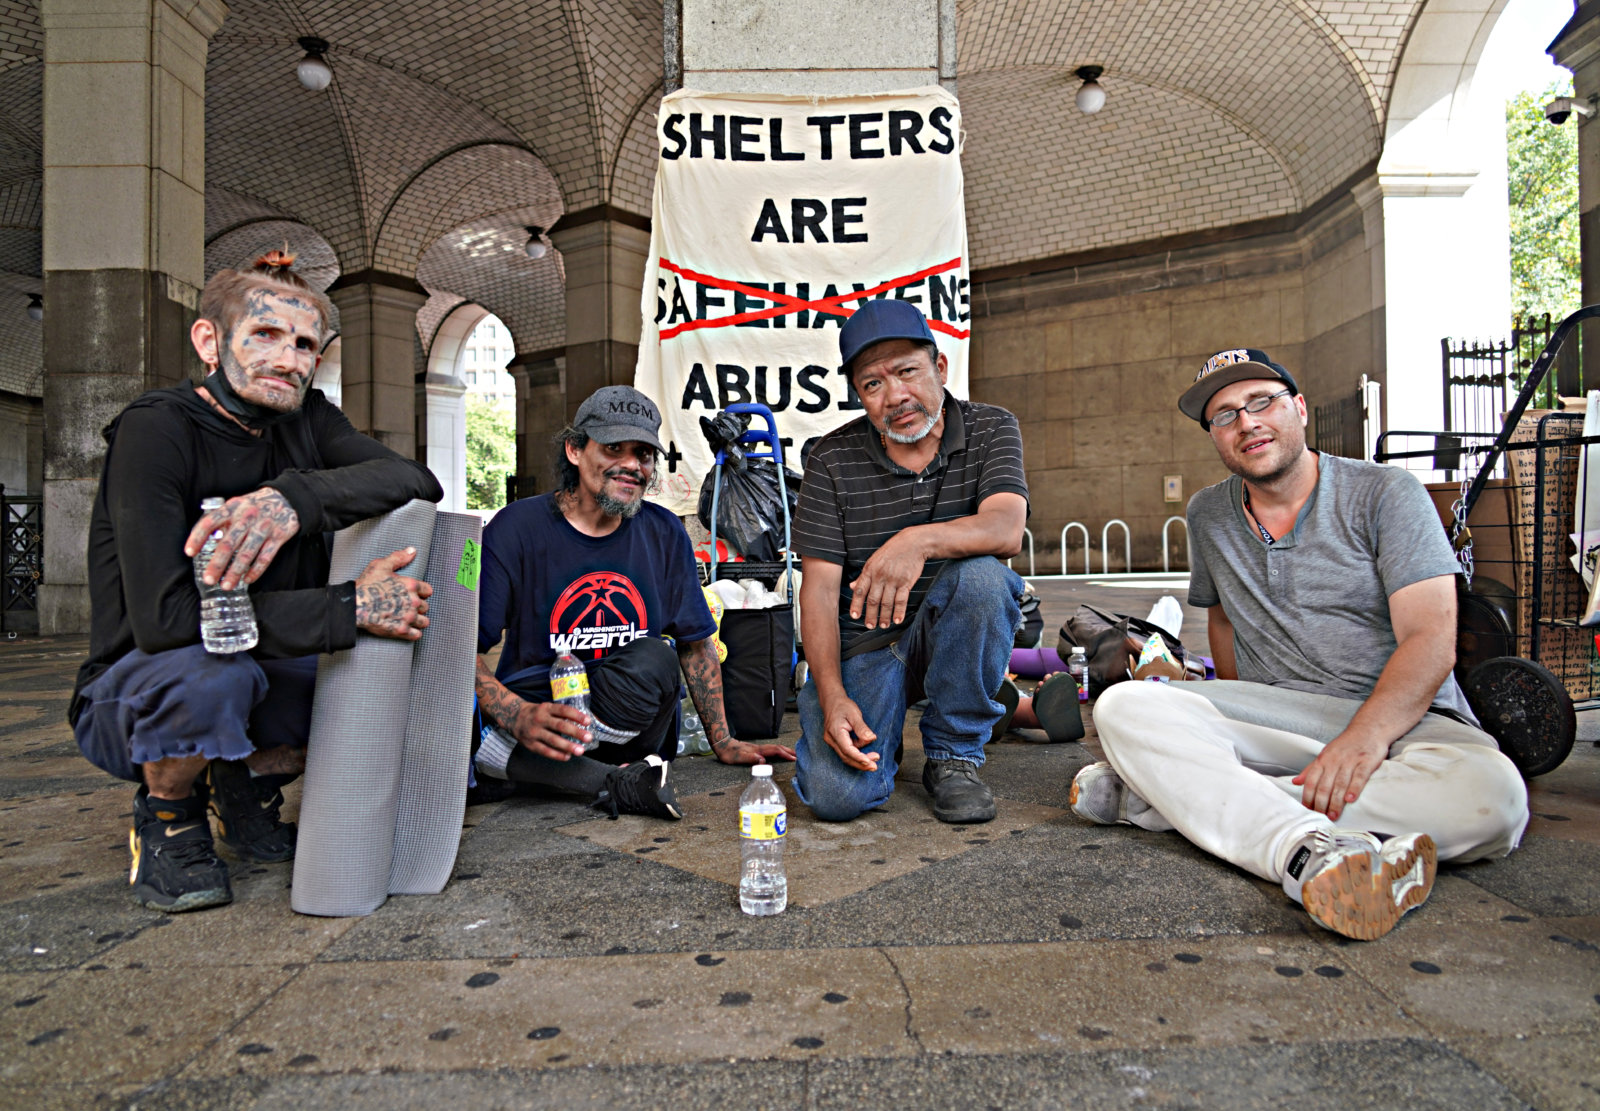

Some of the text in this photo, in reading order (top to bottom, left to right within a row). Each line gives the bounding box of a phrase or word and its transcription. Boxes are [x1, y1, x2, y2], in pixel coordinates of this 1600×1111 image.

[661, 106, 955, 161] SHELTERS
[751, 197, 868, 243] ARE
[607, 401, 654, 420] MGM
[583, 624, 630, 633] WASHINGTON
